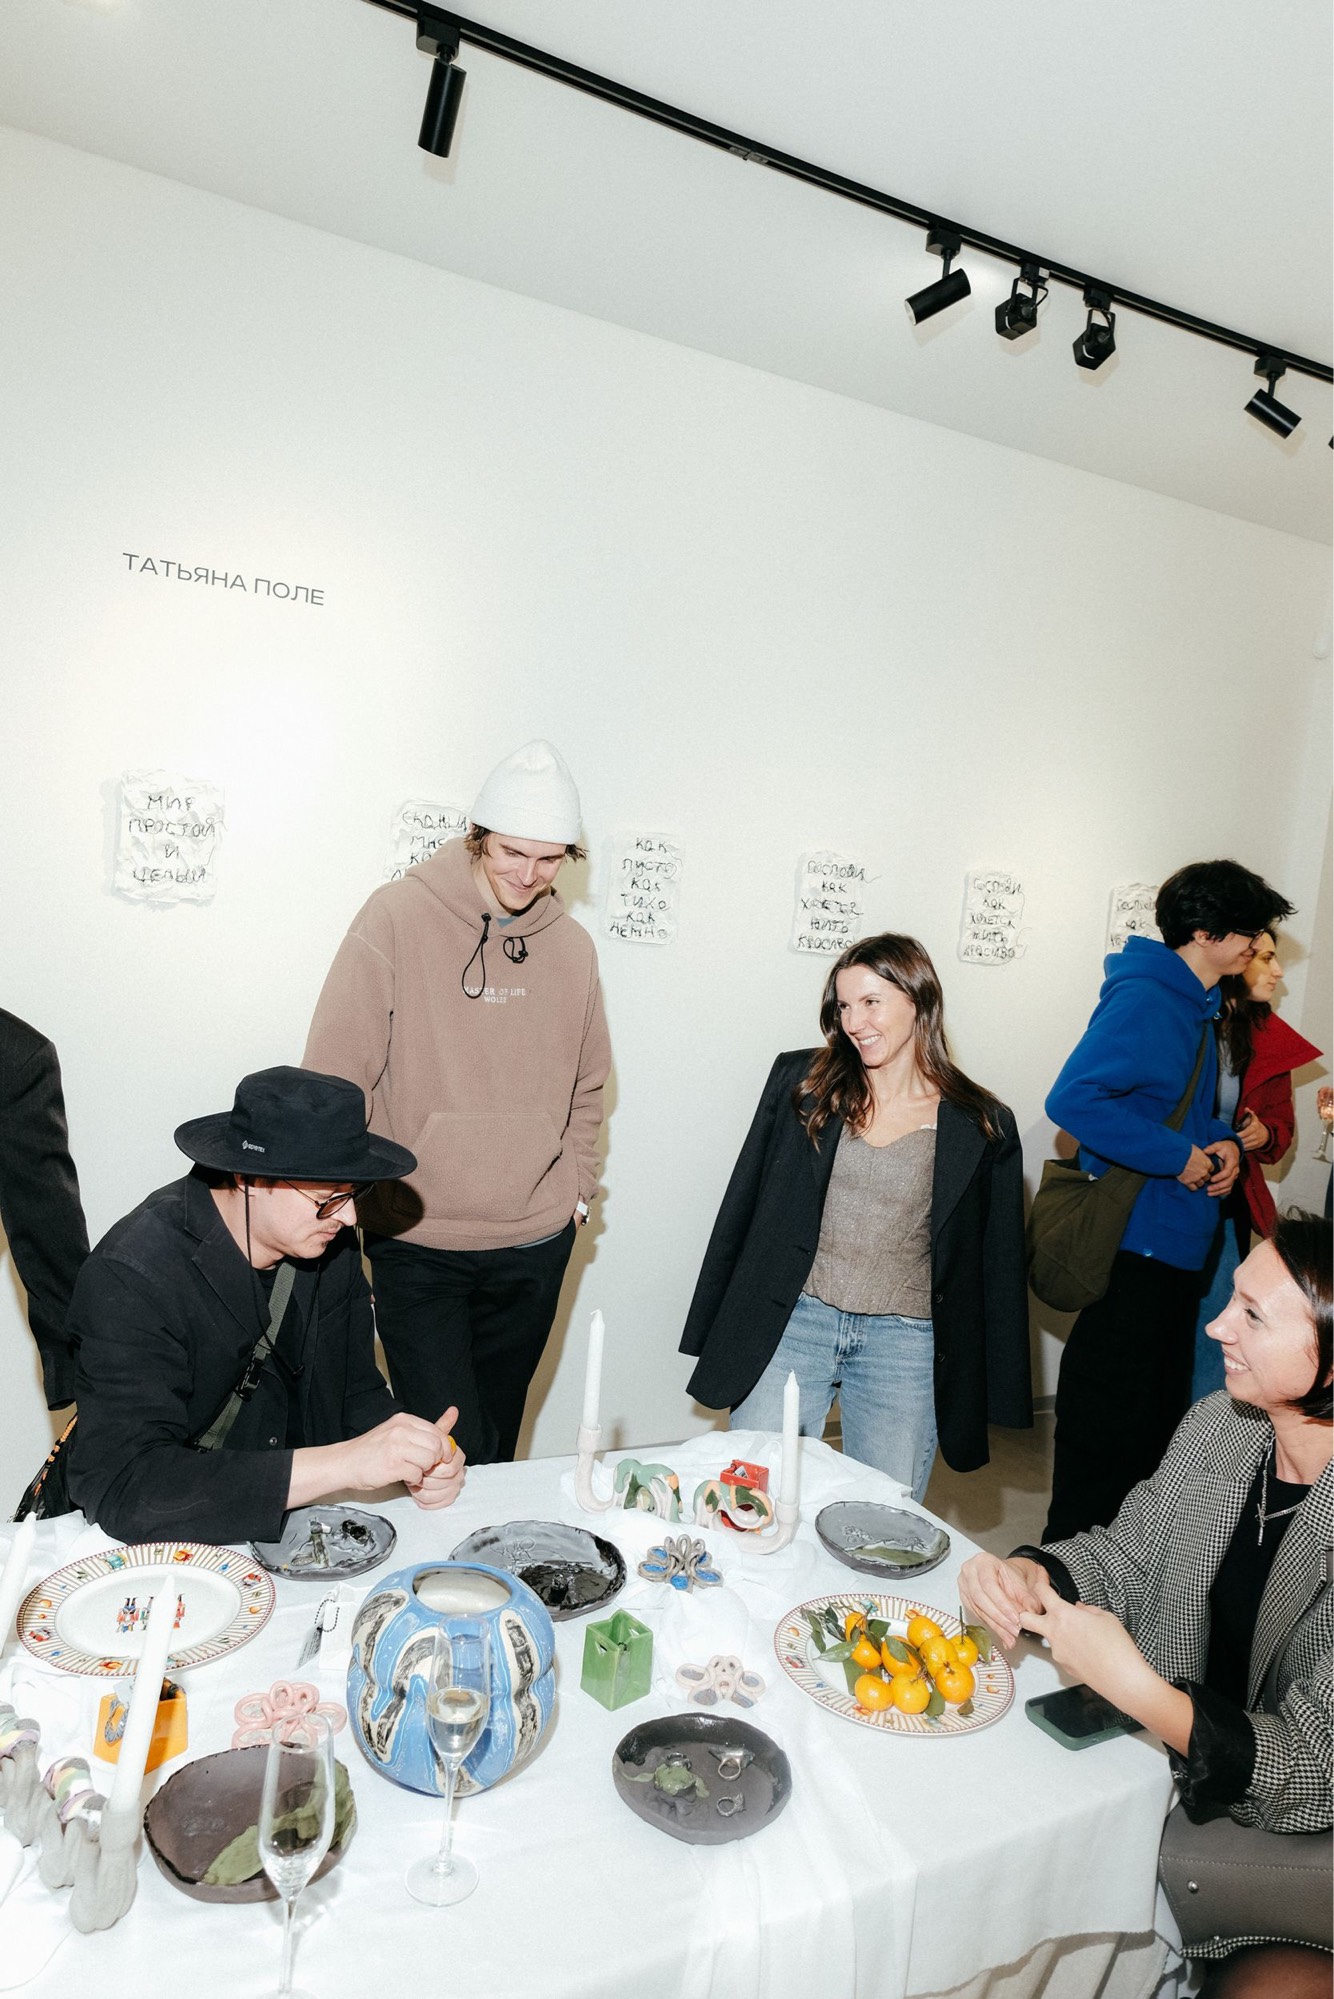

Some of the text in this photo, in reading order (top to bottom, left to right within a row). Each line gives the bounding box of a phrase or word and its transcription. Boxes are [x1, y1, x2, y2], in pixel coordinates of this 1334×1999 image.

[122, 552, 325, 606] ТАТЬЯНА ПОЛЕ
[510, 988, 527, 996] LIFE
